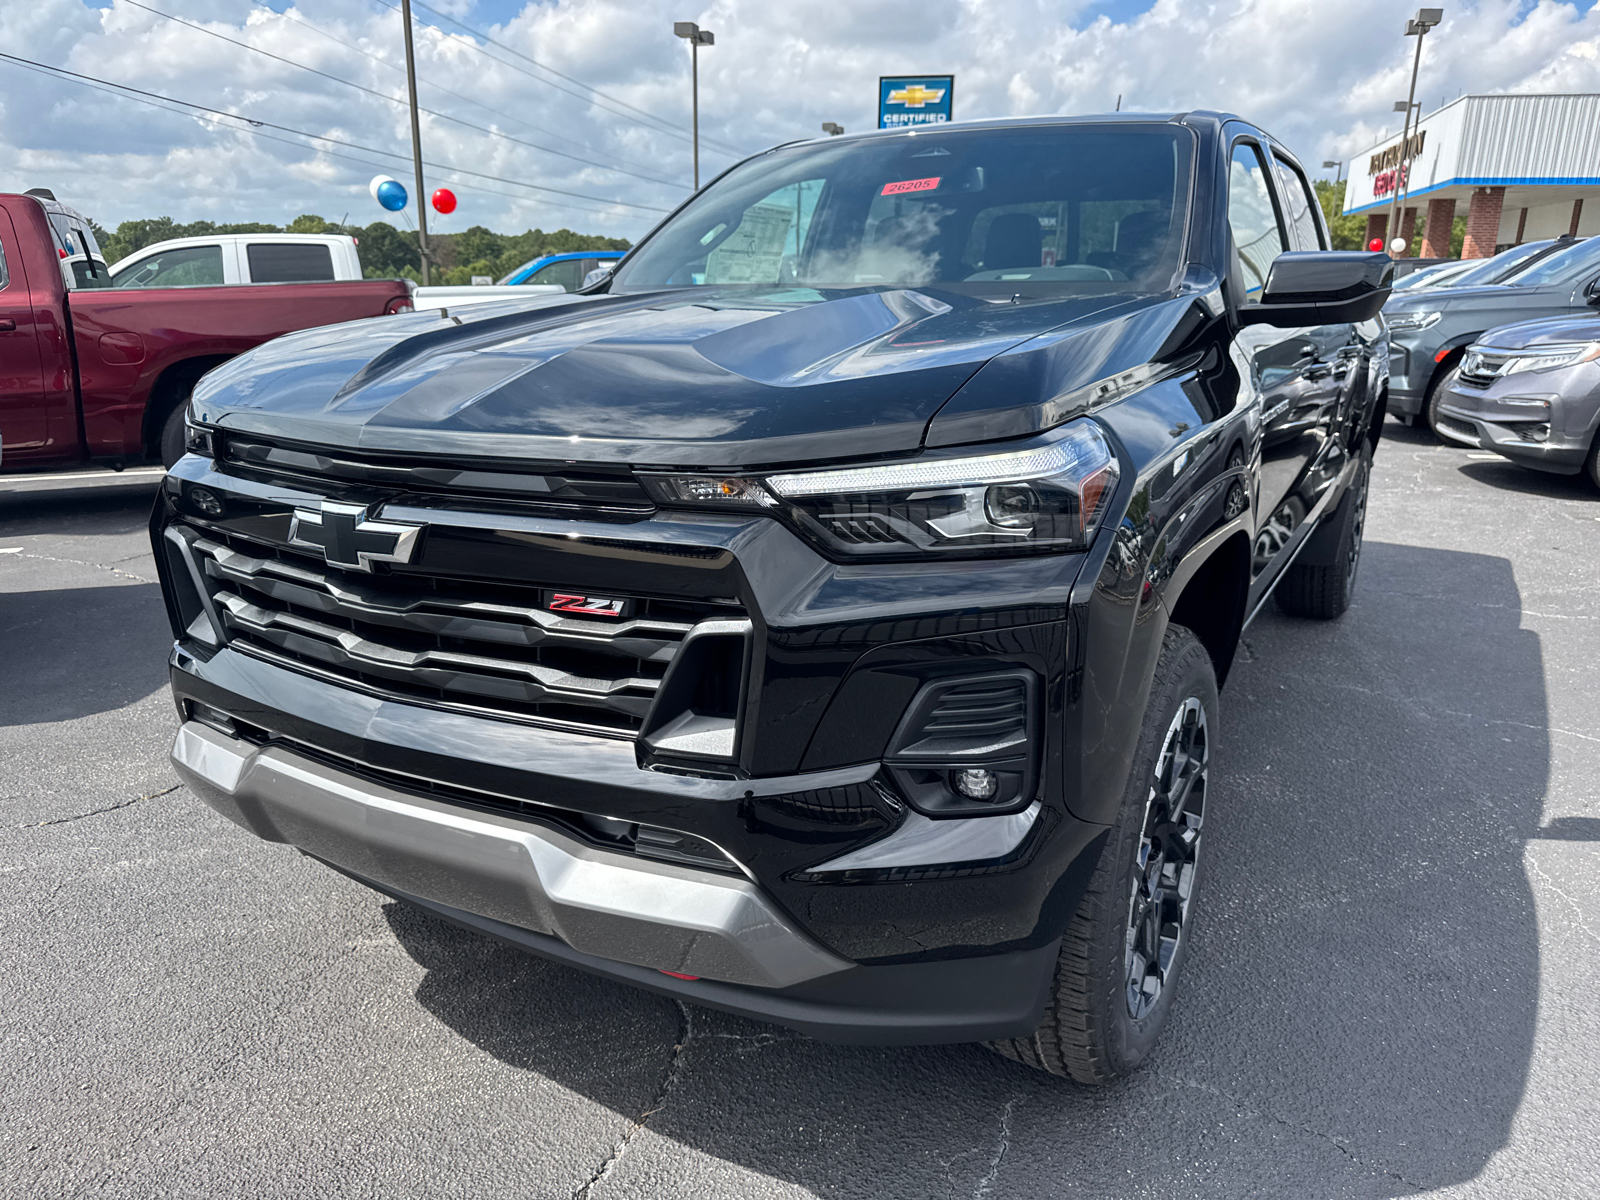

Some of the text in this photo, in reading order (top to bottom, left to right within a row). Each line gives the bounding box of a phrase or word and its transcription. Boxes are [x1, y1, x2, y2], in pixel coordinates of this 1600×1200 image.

[883, 113, 947, 123] CERTIFIED
[888, 180, 931, 192] 26205
[549, 593, 625, 617] Z71
